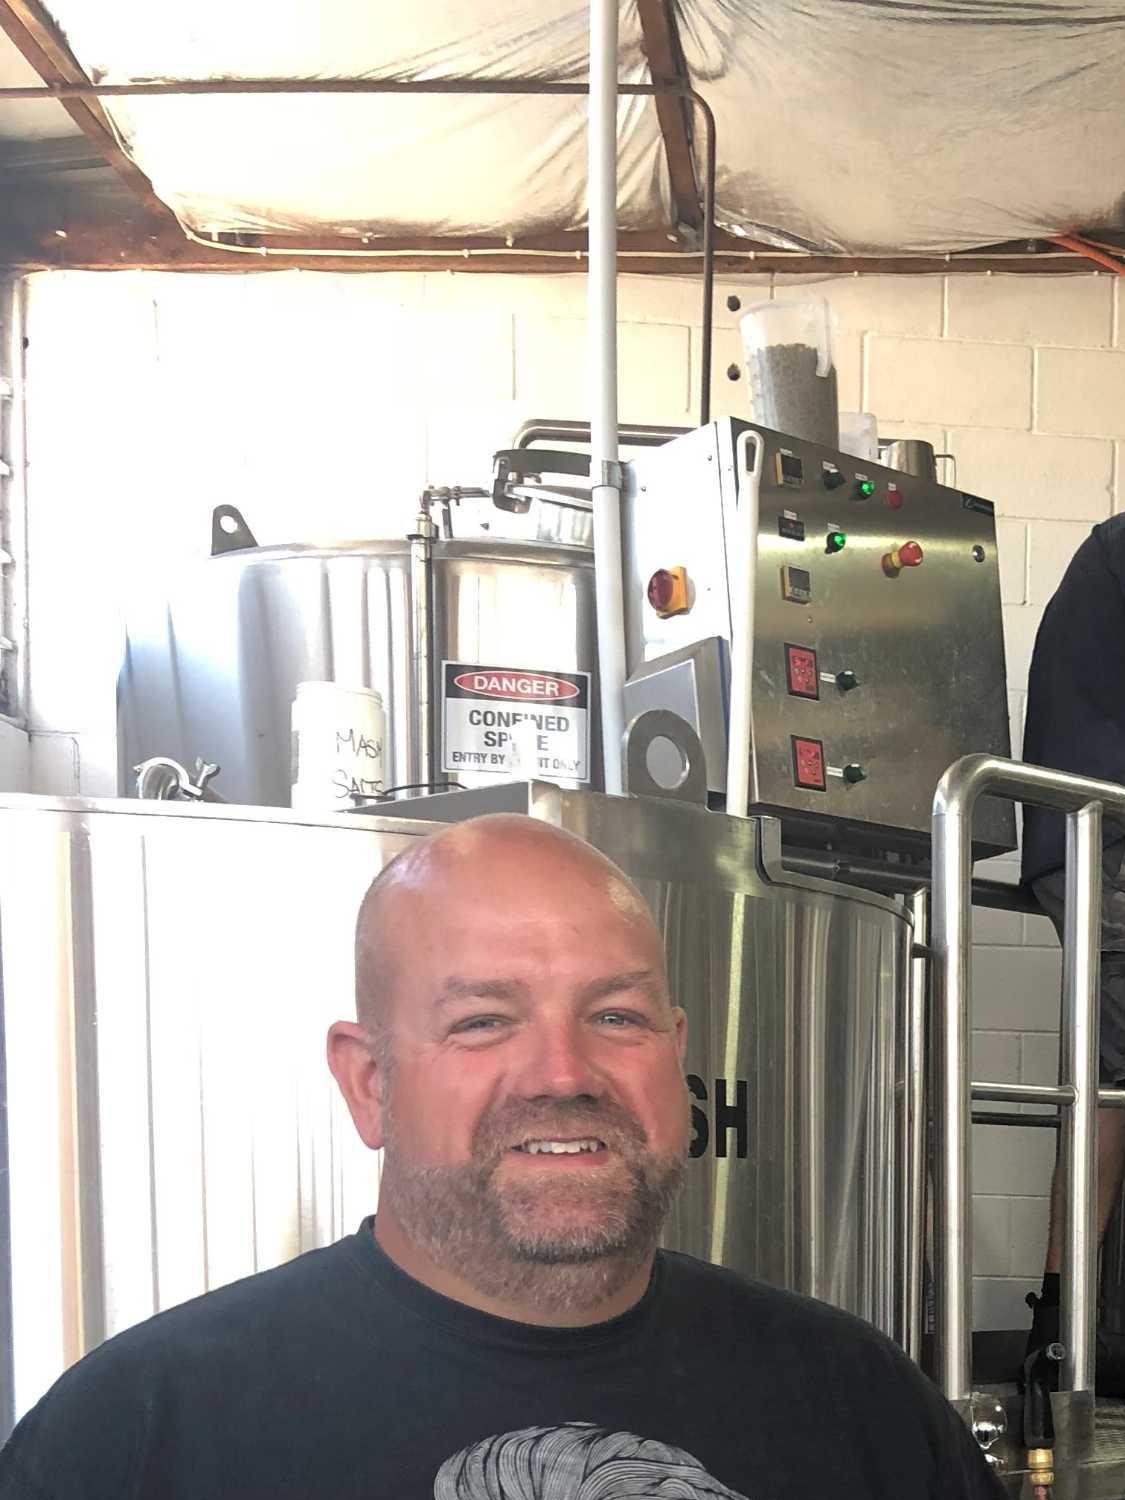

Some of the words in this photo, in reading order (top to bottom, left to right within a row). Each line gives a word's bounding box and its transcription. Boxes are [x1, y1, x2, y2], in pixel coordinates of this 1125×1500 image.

[474, 675, 560, 697] DANGER
[483, 731, 550, 751] SPE
[452, 751, 488, 764] ENTRY
[490, 753, 506, 765] BY
